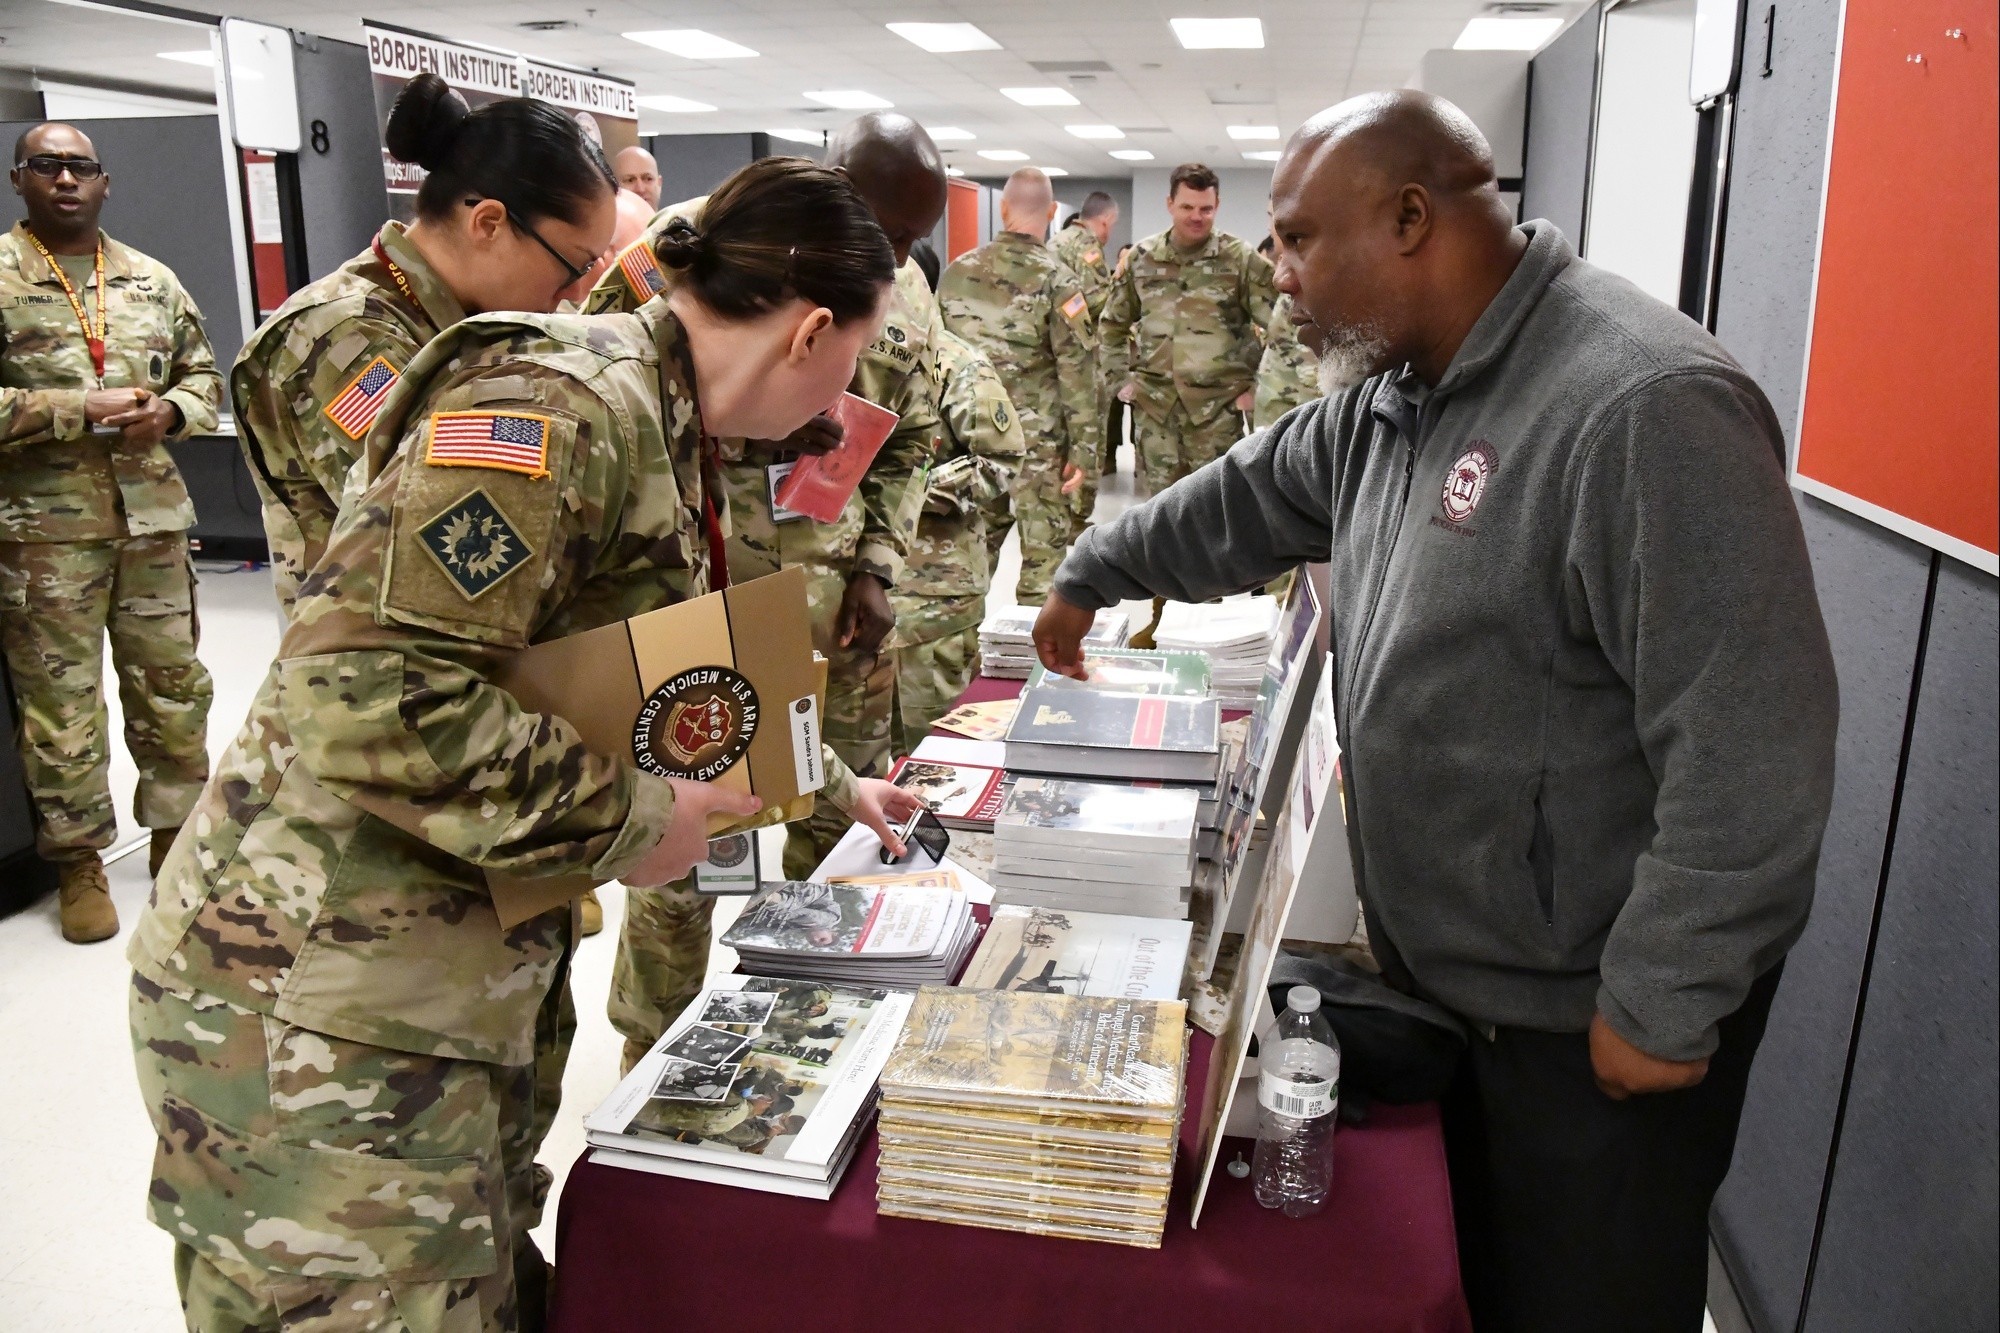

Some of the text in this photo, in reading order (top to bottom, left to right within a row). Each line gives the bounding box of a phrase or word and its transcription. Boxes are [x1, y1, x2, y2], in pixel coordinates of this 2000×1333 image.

[369, 35, 519, 90] BORDEN INSTITUTE
[528, 69, 635, 112] BORDEN INSTITUTE
[311, 119, 330, 155] 8
[388, 262, 411, 297] Here
[69, 292, 84, 318] Starts
[80, 318, 93, 339] Here
[889, 345, 914, 364] ARMY
[658, 670, 720, 699] MEDICAL
[731, 680, 756, 741] U.S. ARMY
[634, 699, 662, 752] CENTER
[638, 752, 656, 768] OF
[804, 736, 812, 757] Sandra
[807, 757, 815, 782] Johnson
[1134, 954, 1155, 965] of
[1137, 938, 1161, 953] Out
[1129, 965, 1153, 981] the
[1124, 982, 1149, 998] Cru
[1110, 1003, 1130, 1033] Through
[1127, 1014, 1145, 1043] Combat
[1064, 1052, 1074, 1065] DAY
[1075, 1040, 1085, 1056] FACE
[1086, 1012, 1111, 1079] Battle of Antietam
[1106, 1035, 1125, 1069] Medicine
[1070, 1067, 1079, 1081] OUR
